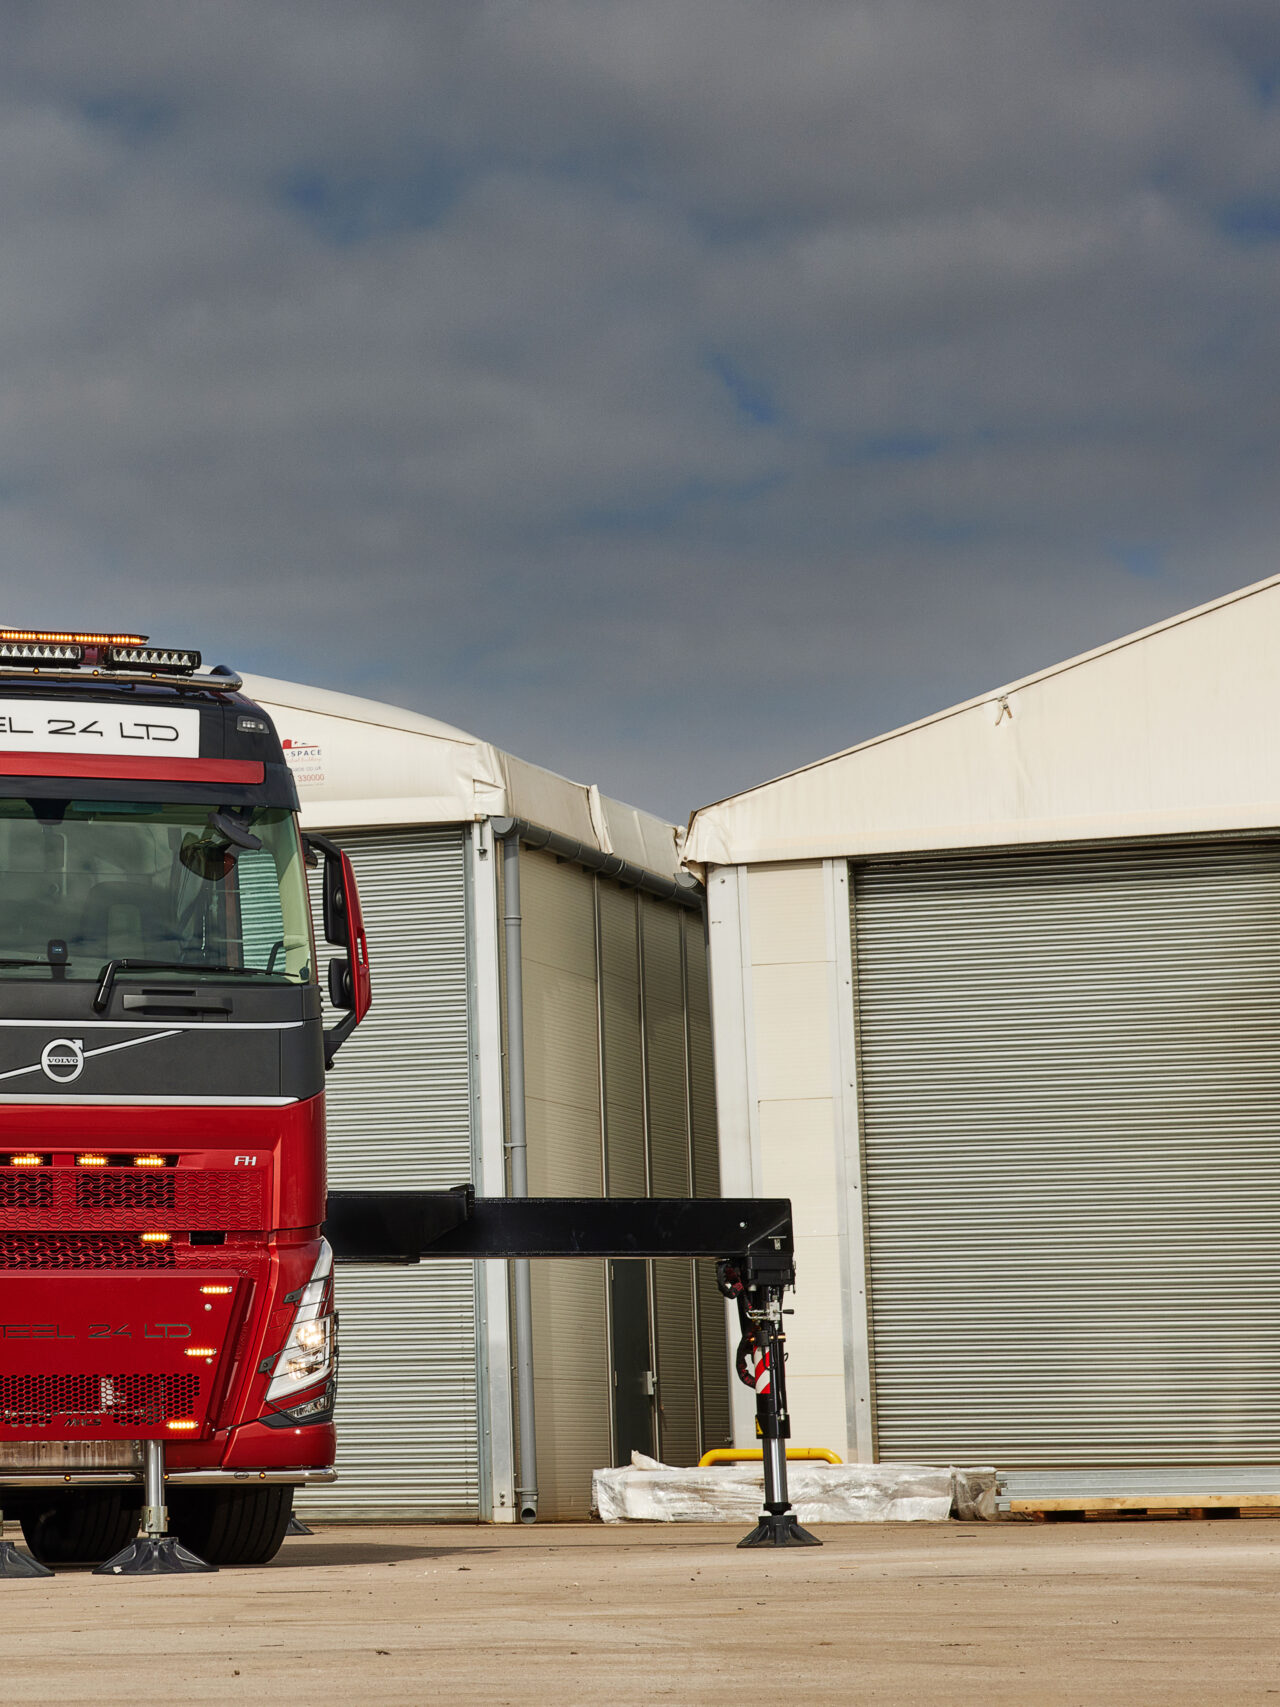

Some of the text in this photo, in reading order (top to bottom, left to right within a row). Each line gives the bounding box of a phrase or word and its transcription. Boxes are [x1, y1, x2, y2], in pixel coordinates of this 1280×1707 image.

[47, 719, 103, 738] 24
[119, 721, 179, 742] LTD
[234, 1155, 257, 1166] FH
[87, 1323, 133, 1339] 24
[143, 1323, 193, 1339] LTD
